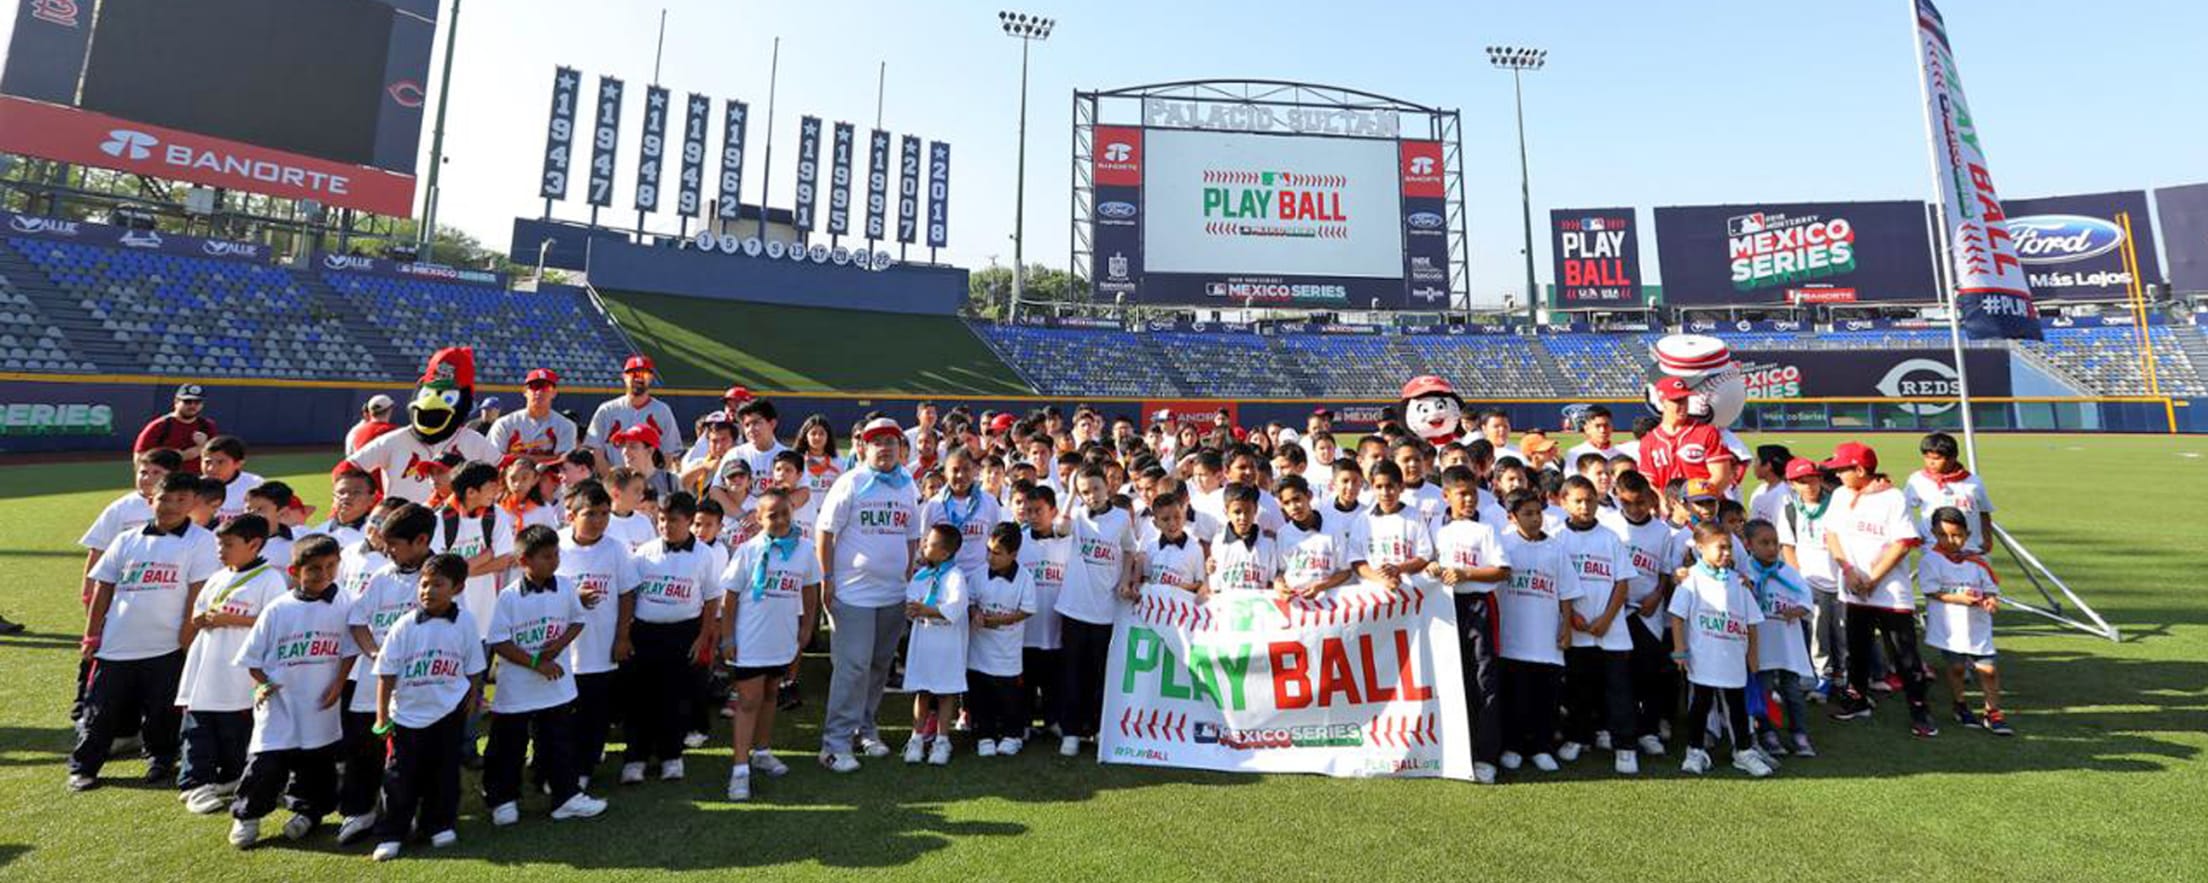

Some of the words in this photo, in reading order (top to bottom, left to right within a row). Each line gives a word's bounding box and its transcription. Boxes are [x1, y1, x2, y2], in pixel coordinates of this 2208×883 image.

[1148, 100, 1274, 131] PALACIO
[1286, 108, 1398, 136] SULTAN
[546, 93, 571, 195] 1943
[591, 102, 615, 201] 1947
[637, 110, 661, 206] 1948
[166, 144, 350, 194] BANORTE
[681, 118, 702, 214] 1949
[720, 127, 740, 216] 1962
[799, 138, 816, 228] 1991
[831, 148, 849, 231] 1995
[868, 155, 886, 235] 1996
[900, 156, 916, 239] 2007
[931, 162, 946, 242] 2018
[1203, 187, 1273, 219] PLAY
[1278, 190, 1347, 221] BALL
[1967, 162, 2020, 277] BALL
[1562, 230, 1626, 258] PLAY
[1729, 218, 1850, 259] MEXICO
[2010, 223, 2093, 254] Ford
[1564, 257, 1631, 286] BALL
[1730, 241, 1851, 281] SERIES
[1228, 283, 1290, 297] MEXICO
[1291, 284, 1347, 298] SERIES
[2029, 272, 2074, 288] Más
[2076, 270, 2134, 288] Lejos
[1745, 366, 1800, 388] XICO
[1746, 382, 1800, 399] RIES
[1901, 380, 1961, 395] REDS
[0, 404, 112, 426] ERIES
[861, 510, 892, 528] PLAY
[1454, 551, 1478, 567] BALL
[1583, 561, 1612, 578] BALL
[1632, 554, 1658, 572] BALL
[142, 568, 179, 584] BALL
[640, 581, 666, 596] PLAY
[665, 582, 692, 599] BALL
[1530, 577, 1556, 594] BALL
[516, 626, 546, 645] PLAY
[1699, 614, 1726, 631] PLAY
[310, 640, 340, 656] BALL
[431, 659, 461, 677] BALL
[1122, 625, 1252, 711] PLAY
[1268, 629, 1434, 711] BALL
[1219, 727, 1290, 745] MEXICO
[1291, 723, 1362, 744] SERIES
[1114, 748, 1169, 762] #PLAYBALL
